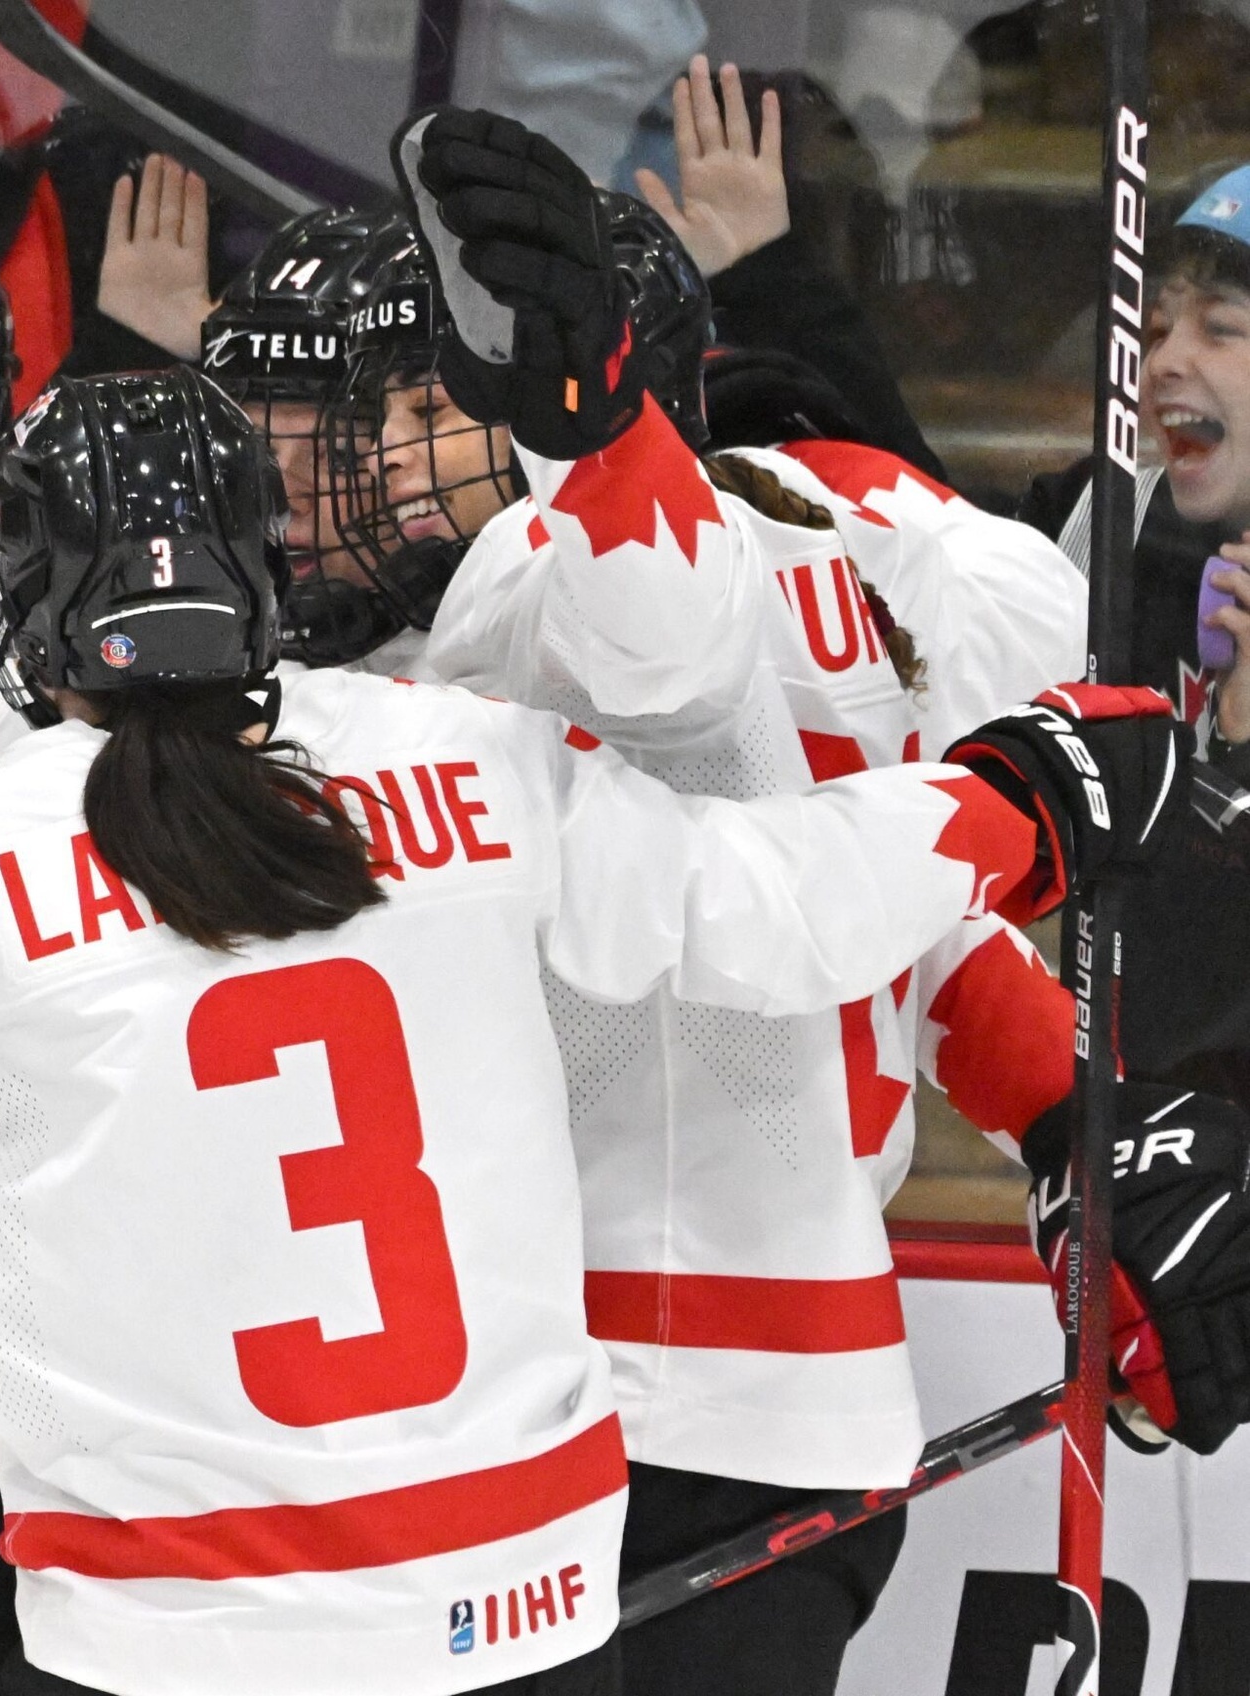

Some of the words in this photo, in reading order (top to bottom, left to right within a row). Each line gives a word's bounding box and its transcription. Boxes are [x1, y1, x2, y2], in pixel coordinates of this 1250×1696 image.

[269, 258, 322, 290] 14
[349, 299, 417, 337] TELUS
[249, 333, 337, 360] TELU
[150, 537, 173, 588] 3
[186, 957, 467, 1427] 3
[1066, 1241, 1081, 1336] LAROCQUE
[485, 1563, 586, 1645] IIHF
